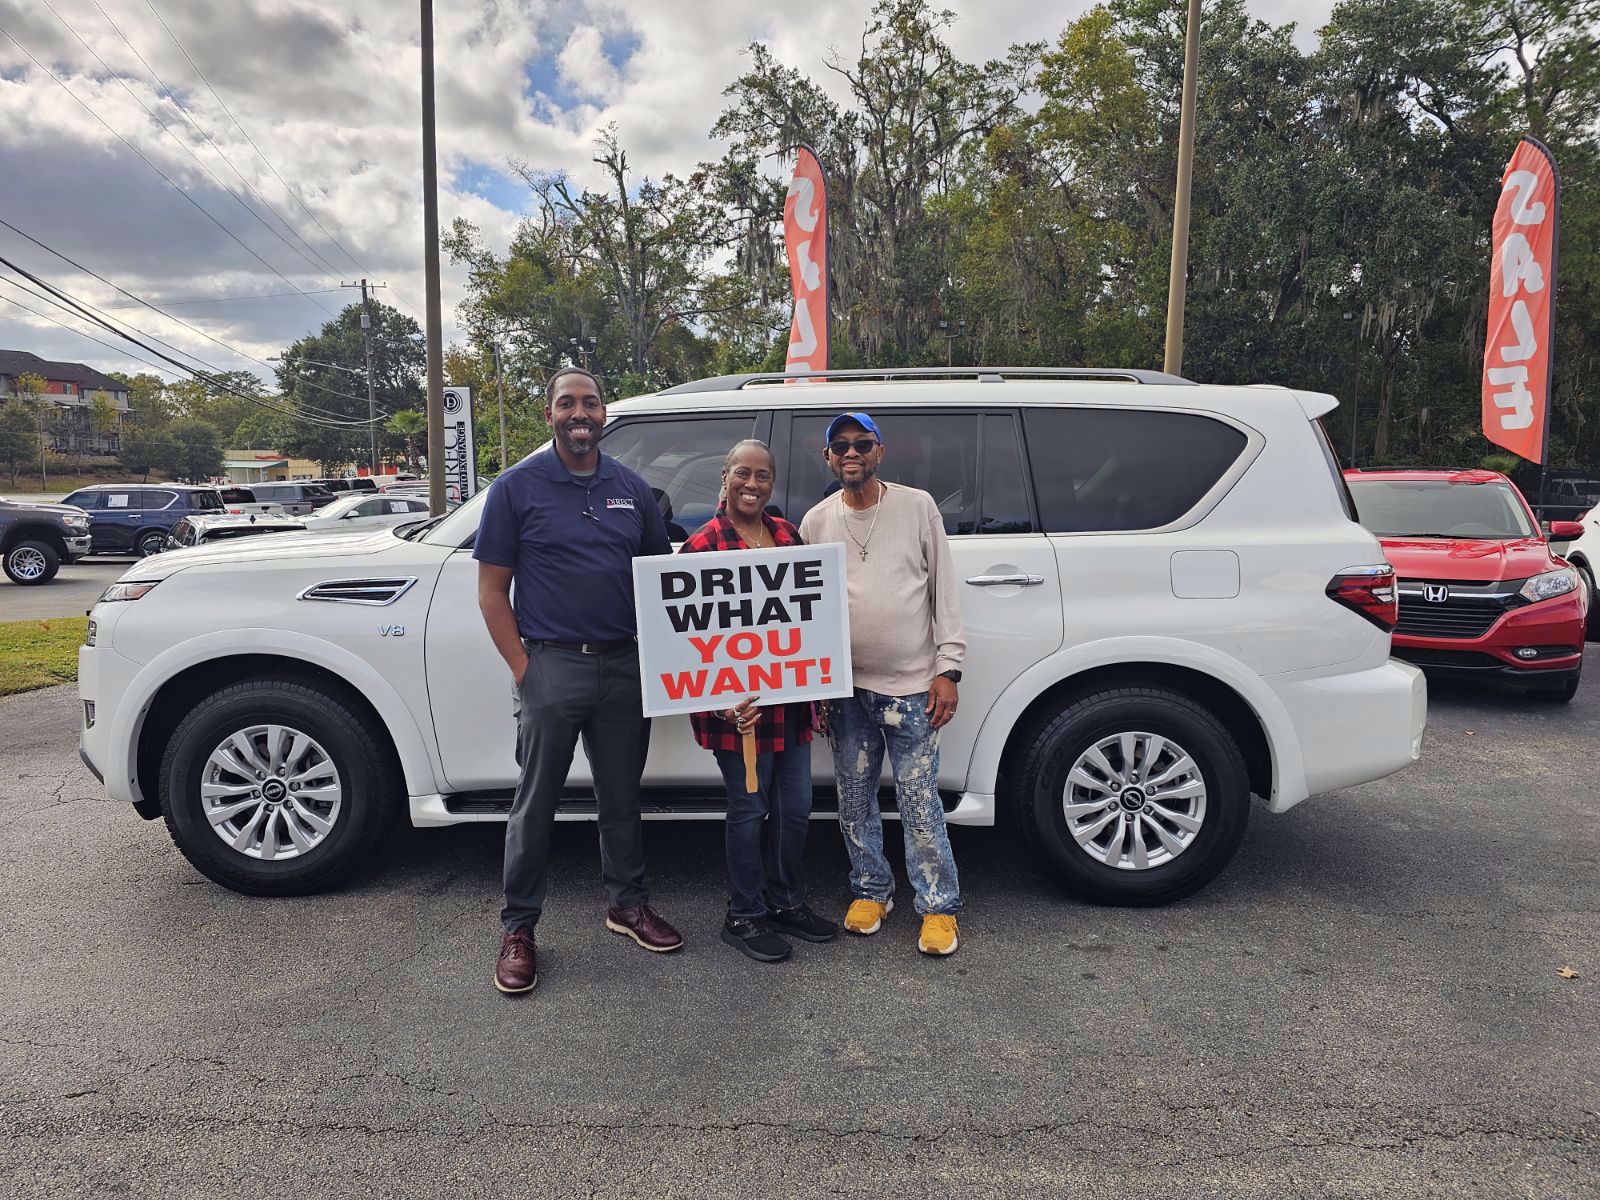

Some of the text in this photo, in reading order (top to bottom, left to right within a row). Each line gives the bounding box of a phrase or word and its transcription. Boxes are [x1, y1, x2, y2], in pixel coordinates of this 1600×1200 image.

[457, 424, 469, 500] AUTO EXCHANGE
[660, 560, 823, 600] DRIVE
[376, 624, 405, 637] V8
[665, 593, 821, 633] WHAT
[688, 628, 802, 664] YOU
[660, 657, 832, 700] WANT!
